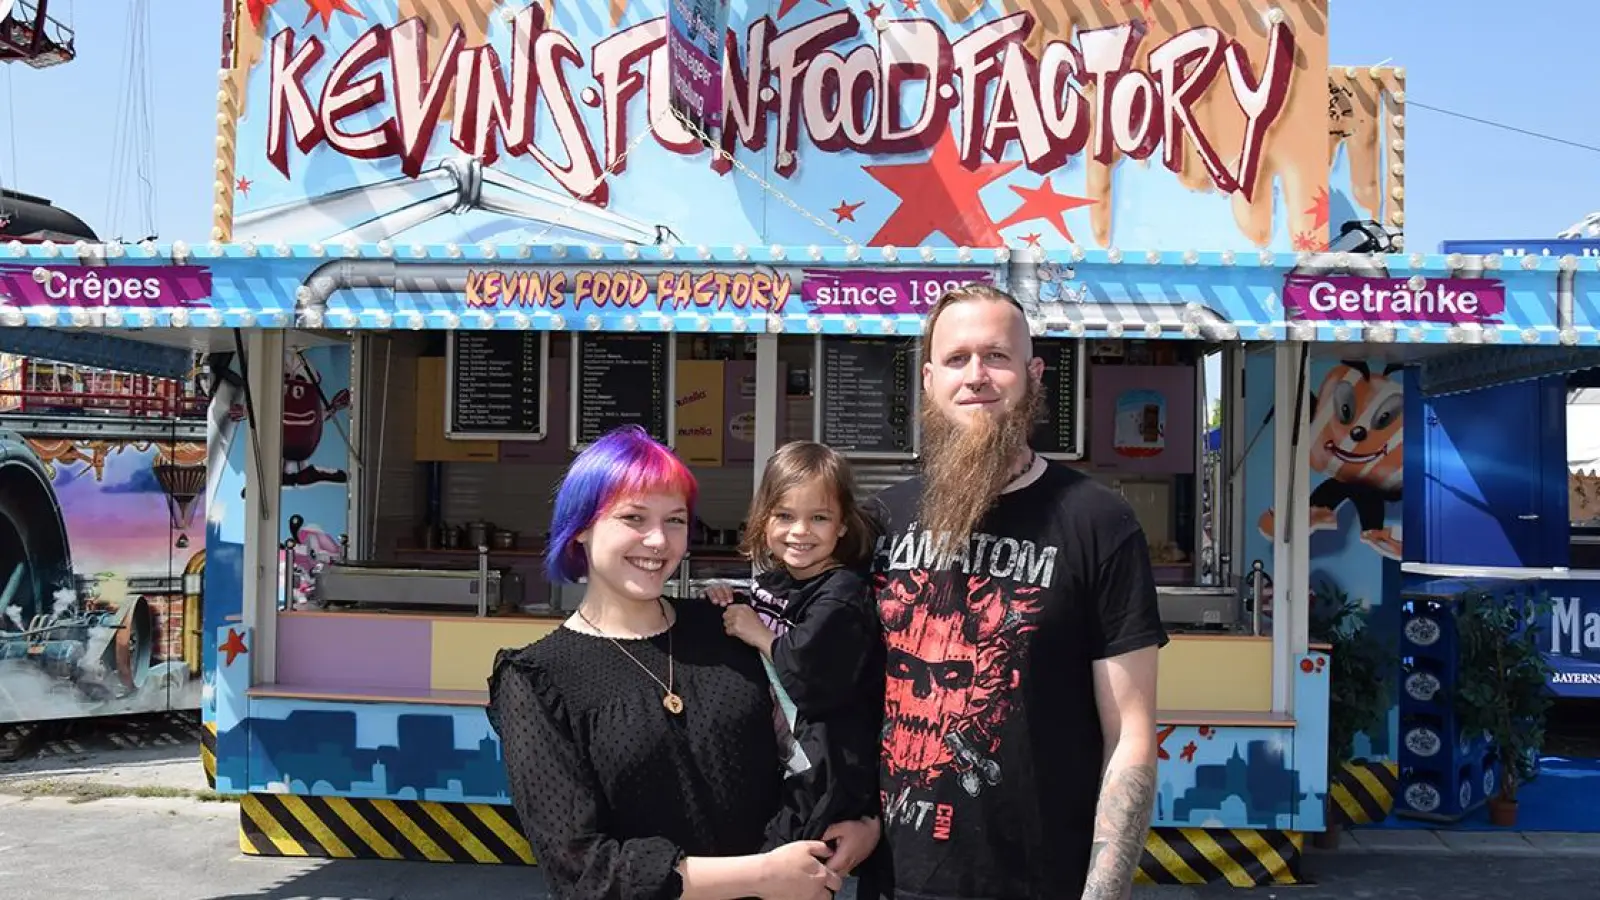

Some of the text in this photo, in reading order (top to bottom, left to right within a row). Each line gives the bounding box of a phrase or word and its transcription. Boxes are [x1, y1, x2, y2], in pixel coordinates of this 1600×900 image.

[44, 270, 161, 306] Crêpes
[464, 270, 792, 309] KEVINS FOOD FACTORY
[815, 280, 975, 306] since 19
[1308, 281, 1479, 314] Getränke
